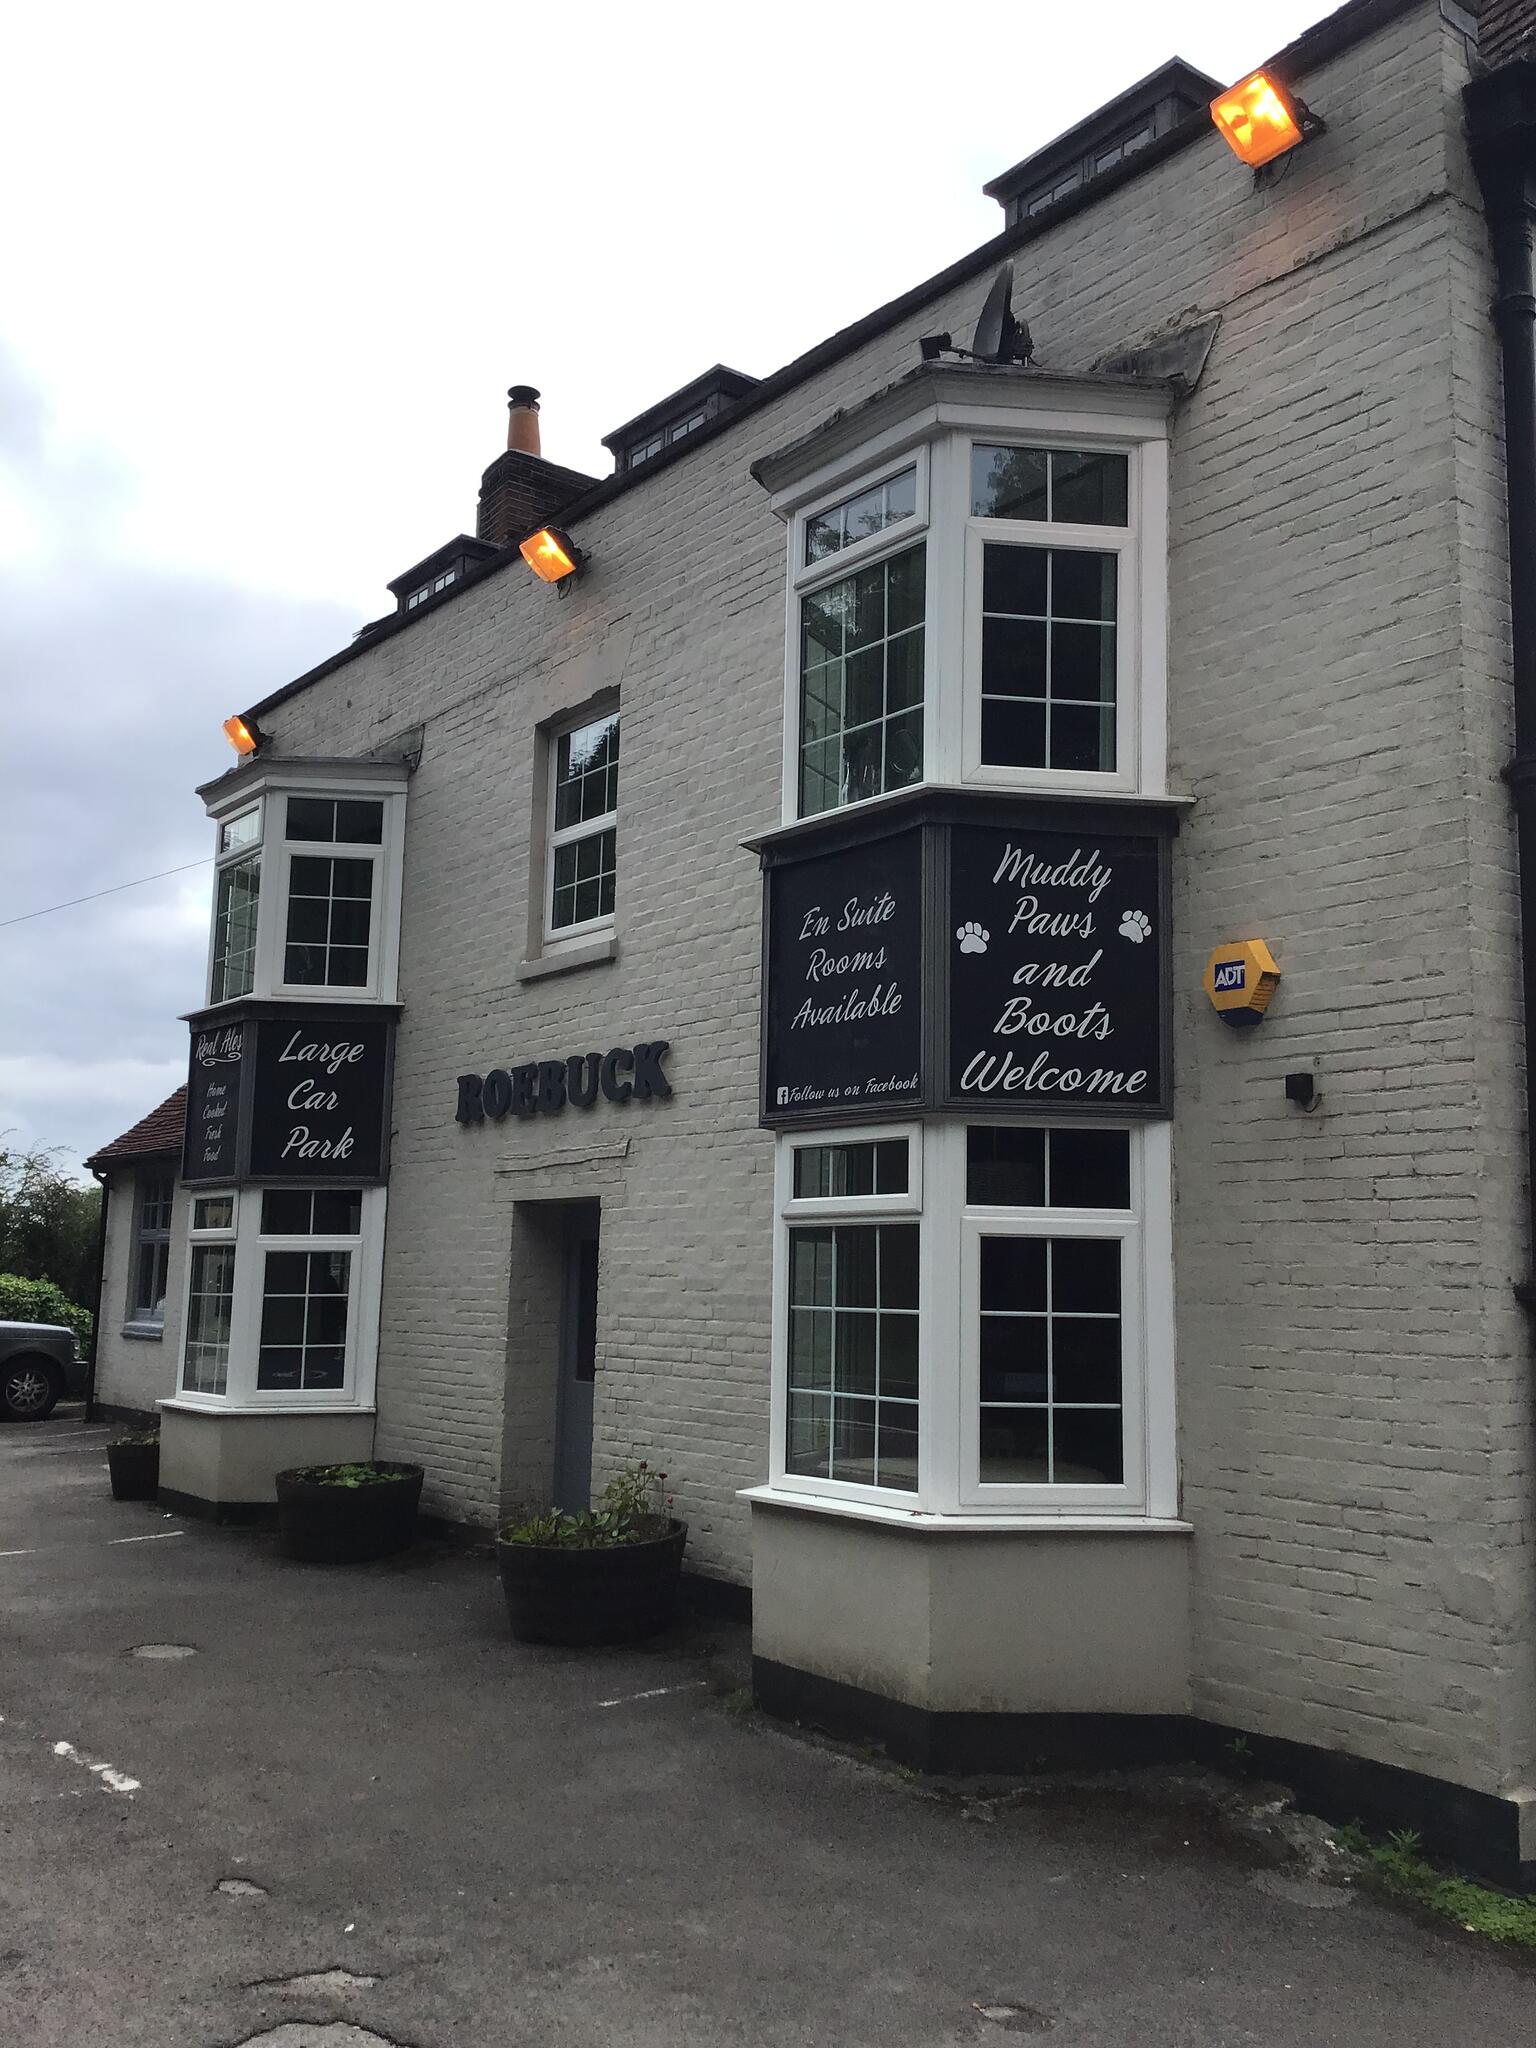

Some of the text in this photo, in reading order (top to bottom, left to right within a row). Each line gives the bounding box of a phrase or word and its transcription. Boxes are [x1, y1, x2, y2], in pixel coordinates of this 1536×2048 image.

[992, 843, 1112, 901] Muddy
[799, 892, 896, 941] En Suite
[1007, 896, 1096, 938] Paws
[805, 946, 887, 982] Rooms
[1012, 949, 1103, 988] and
[1215, 964, 1245, 988] ADT
[790, 982, 902, 1030] Available
[993, 996, 1114, 1041] Boots
[195, 1027, 242, 1061] Real Ales
[278, 1030, 364, 1074] Large
[206, 1082, 226, 1097] Home
[455, 1040, 672, 1124] ROEBUCK
[788, 1086, 825, 1103] Follow
[828, 1086, 840, 1097] us
[844, 1084, 860, 1097] on
[865, 1073, 919, 1092] Facebook
[960, 1050, 1147, 1094] Welcome
[202, 1101, 227, 1120] Cooked
[287, 1078, 338, 1110] Car
[203, 1145, 221, 1162] Food
[281, 1126, 354, 1159] Park
